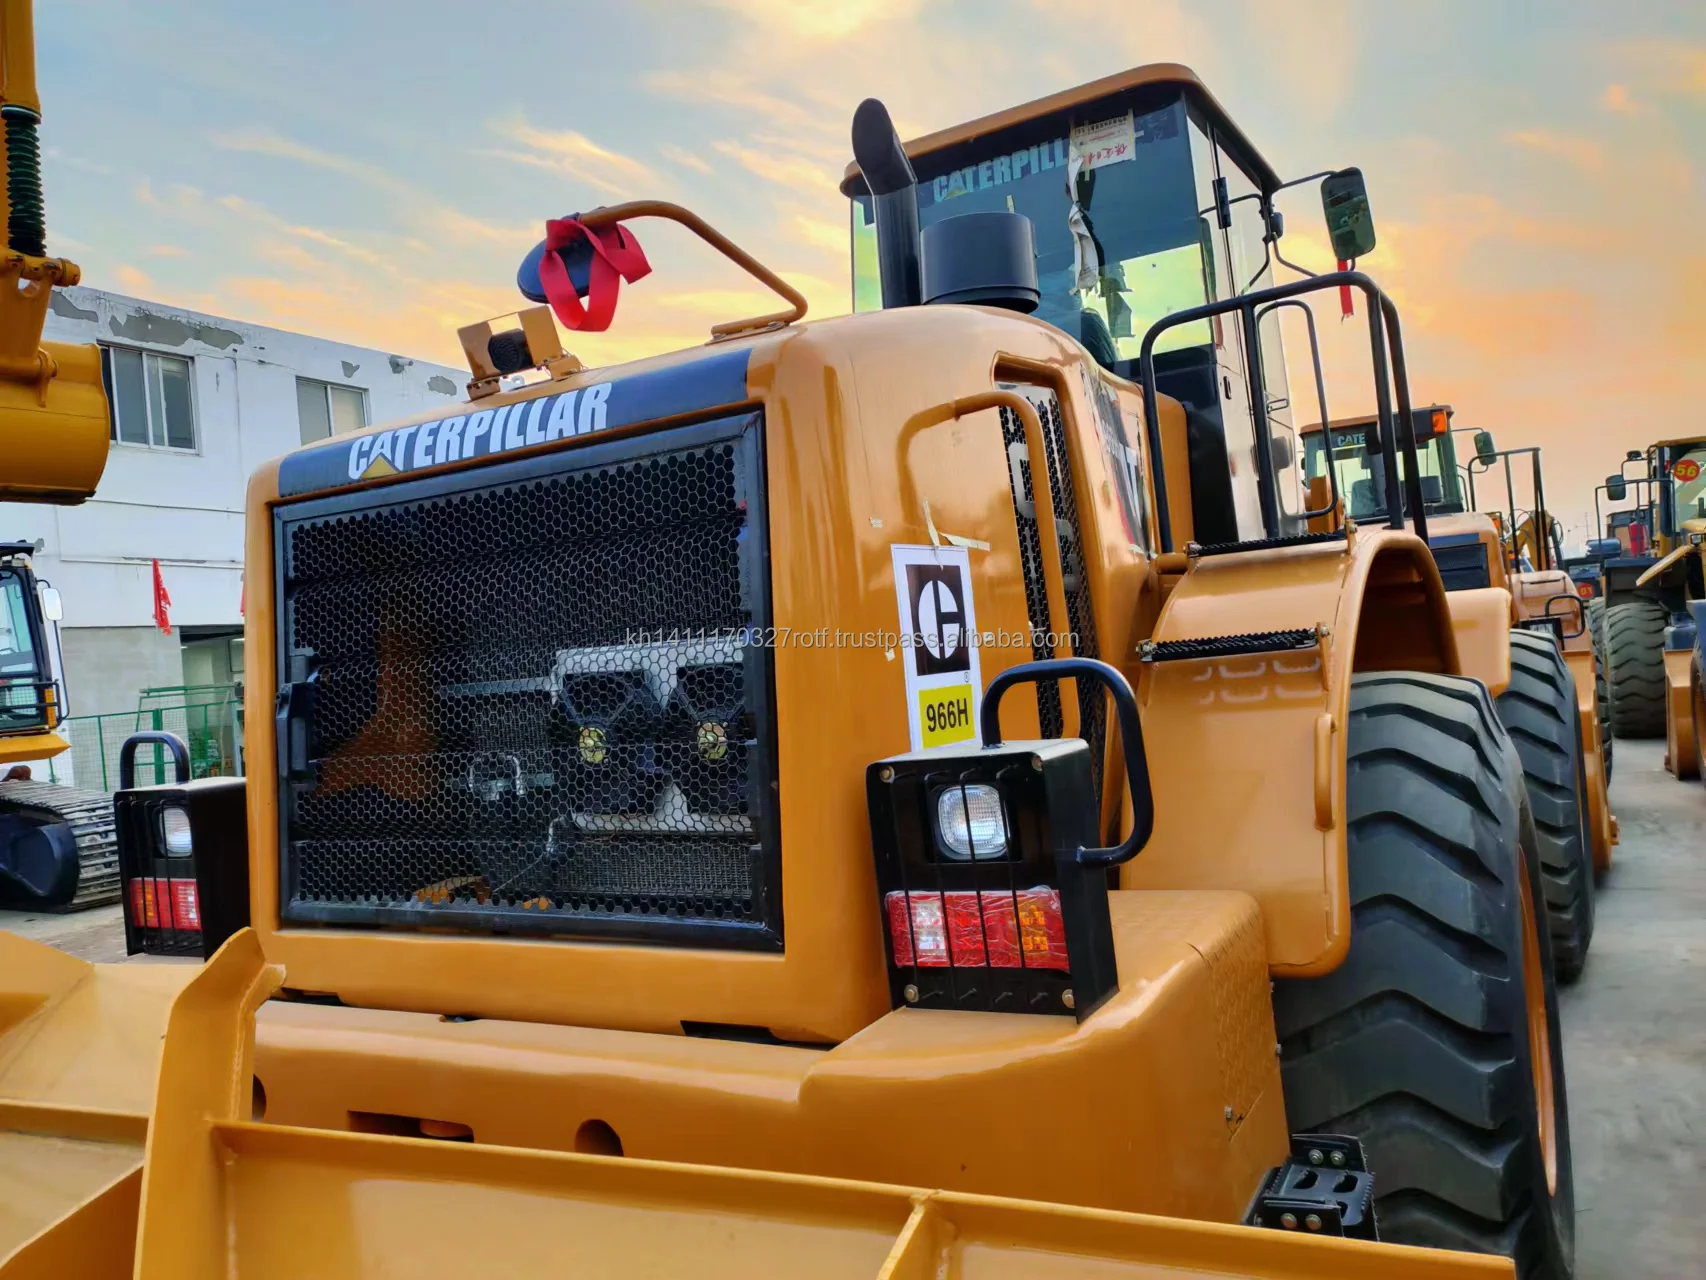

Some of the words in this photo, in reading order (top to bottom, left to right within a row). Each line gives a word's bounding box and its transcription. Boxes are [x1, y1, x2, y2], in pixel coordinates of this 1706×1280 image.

[933, 137, 1069, 203] CATERPILL
[348, 382, 612, 479] CATERPILLAR
[1675, 465, 1697, 477] 56
[926, 697, 969, 733] 966H
